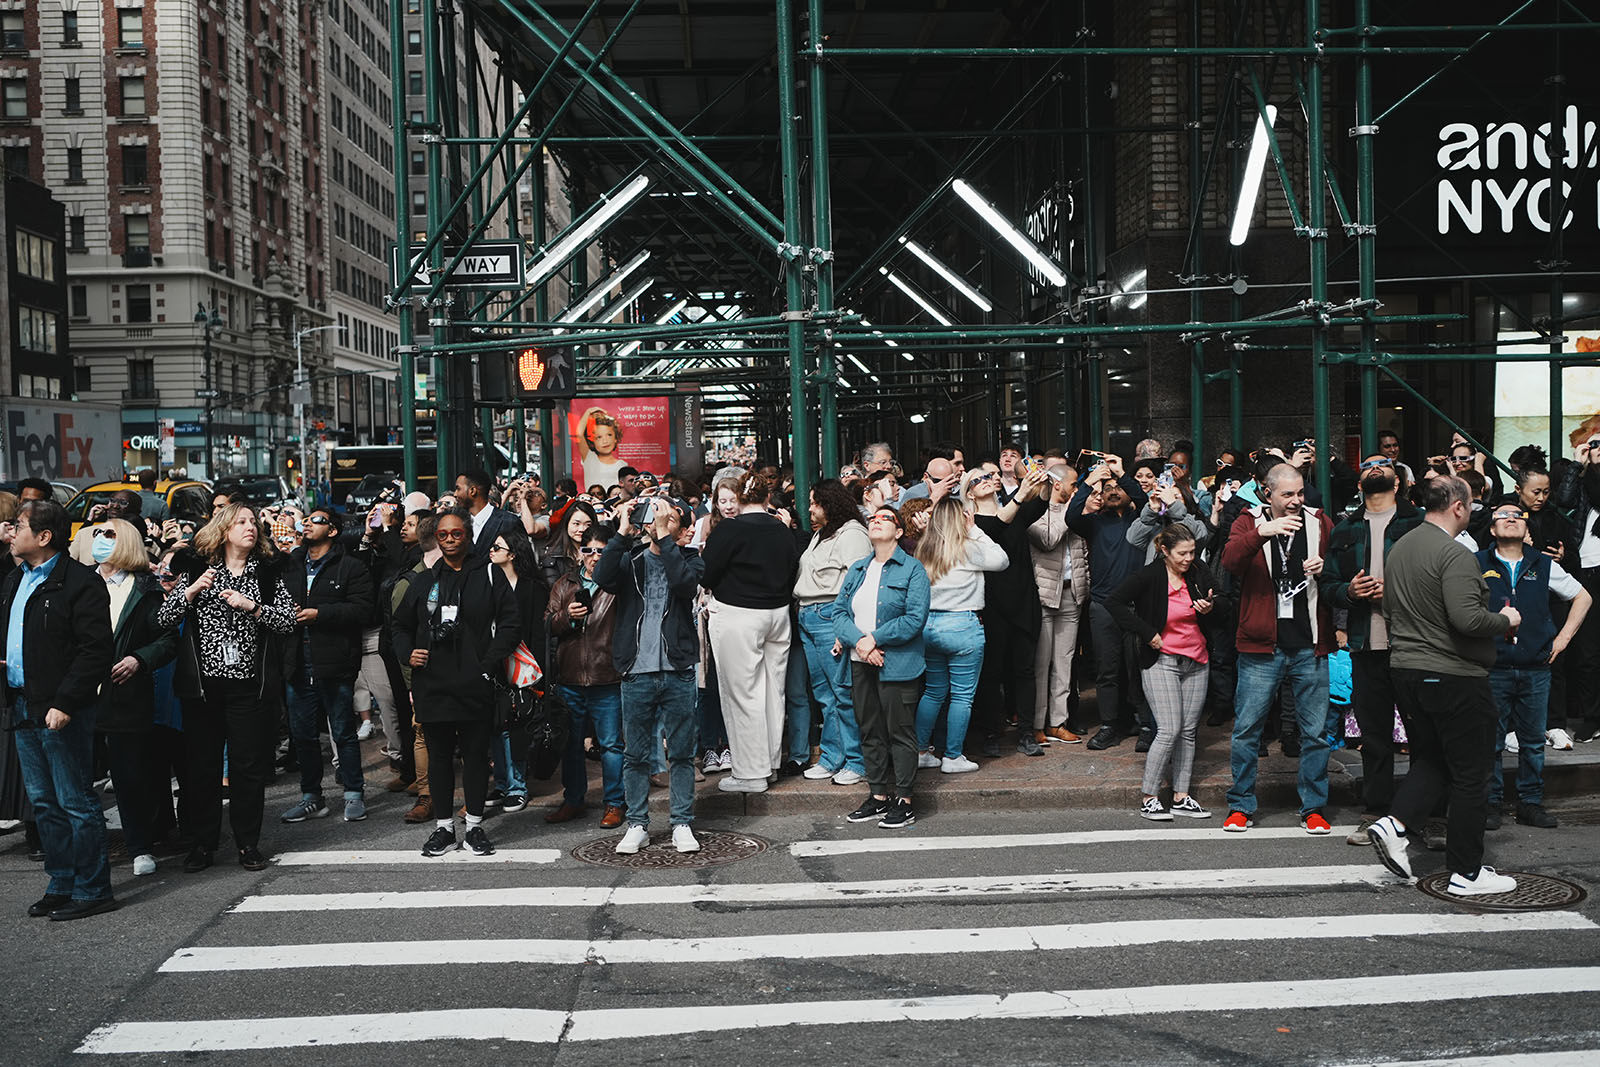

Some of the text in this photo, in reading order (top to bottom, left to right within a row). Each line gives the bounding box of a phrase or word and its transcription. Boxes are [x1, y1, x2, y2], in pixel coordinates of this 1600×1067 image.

[1438, 178, 1573, 235] NYC
[463, 257, 500, 273] WAY
[8, 410, 95, 480] FedEx
[131, 435, 160, 449] Offic
[685, 396, 694, 448] Newsstand
